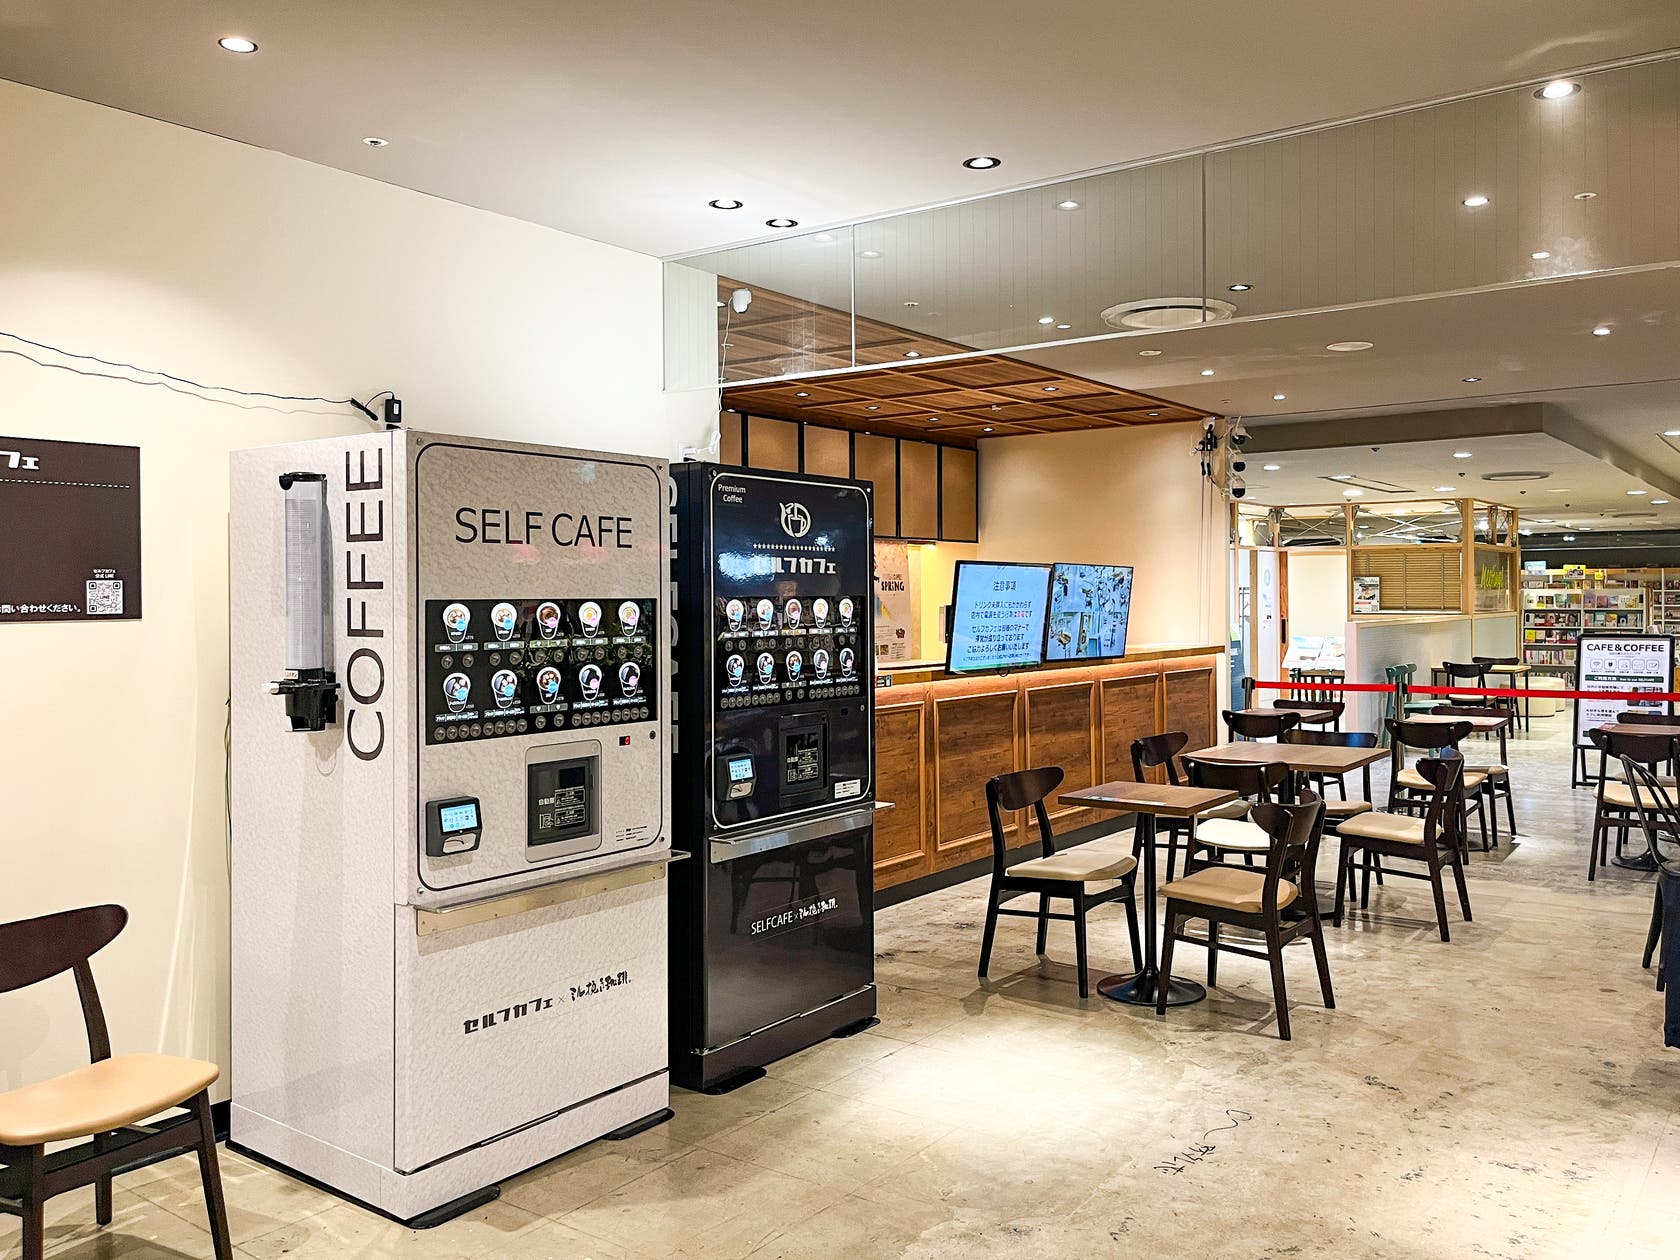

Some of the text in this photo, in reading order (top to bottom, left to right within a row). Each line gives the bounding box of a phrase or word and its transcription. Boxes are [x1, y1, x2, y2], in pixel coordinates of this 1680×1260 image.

[718, 483, 746, 494] Premium
[723, 494, 743, 503] Coffee
[455, 507, 632, 549] SELF CAFE
[755, 556, 836, 574] ルフカフェ
[0, 603, 81, 614] 問い合わせください。
[345, 447, 384, 761] COFFEE
[751, 910, 794, 935] SELFCAFE
[463, 997, 554, 1035] セルフカフェ
